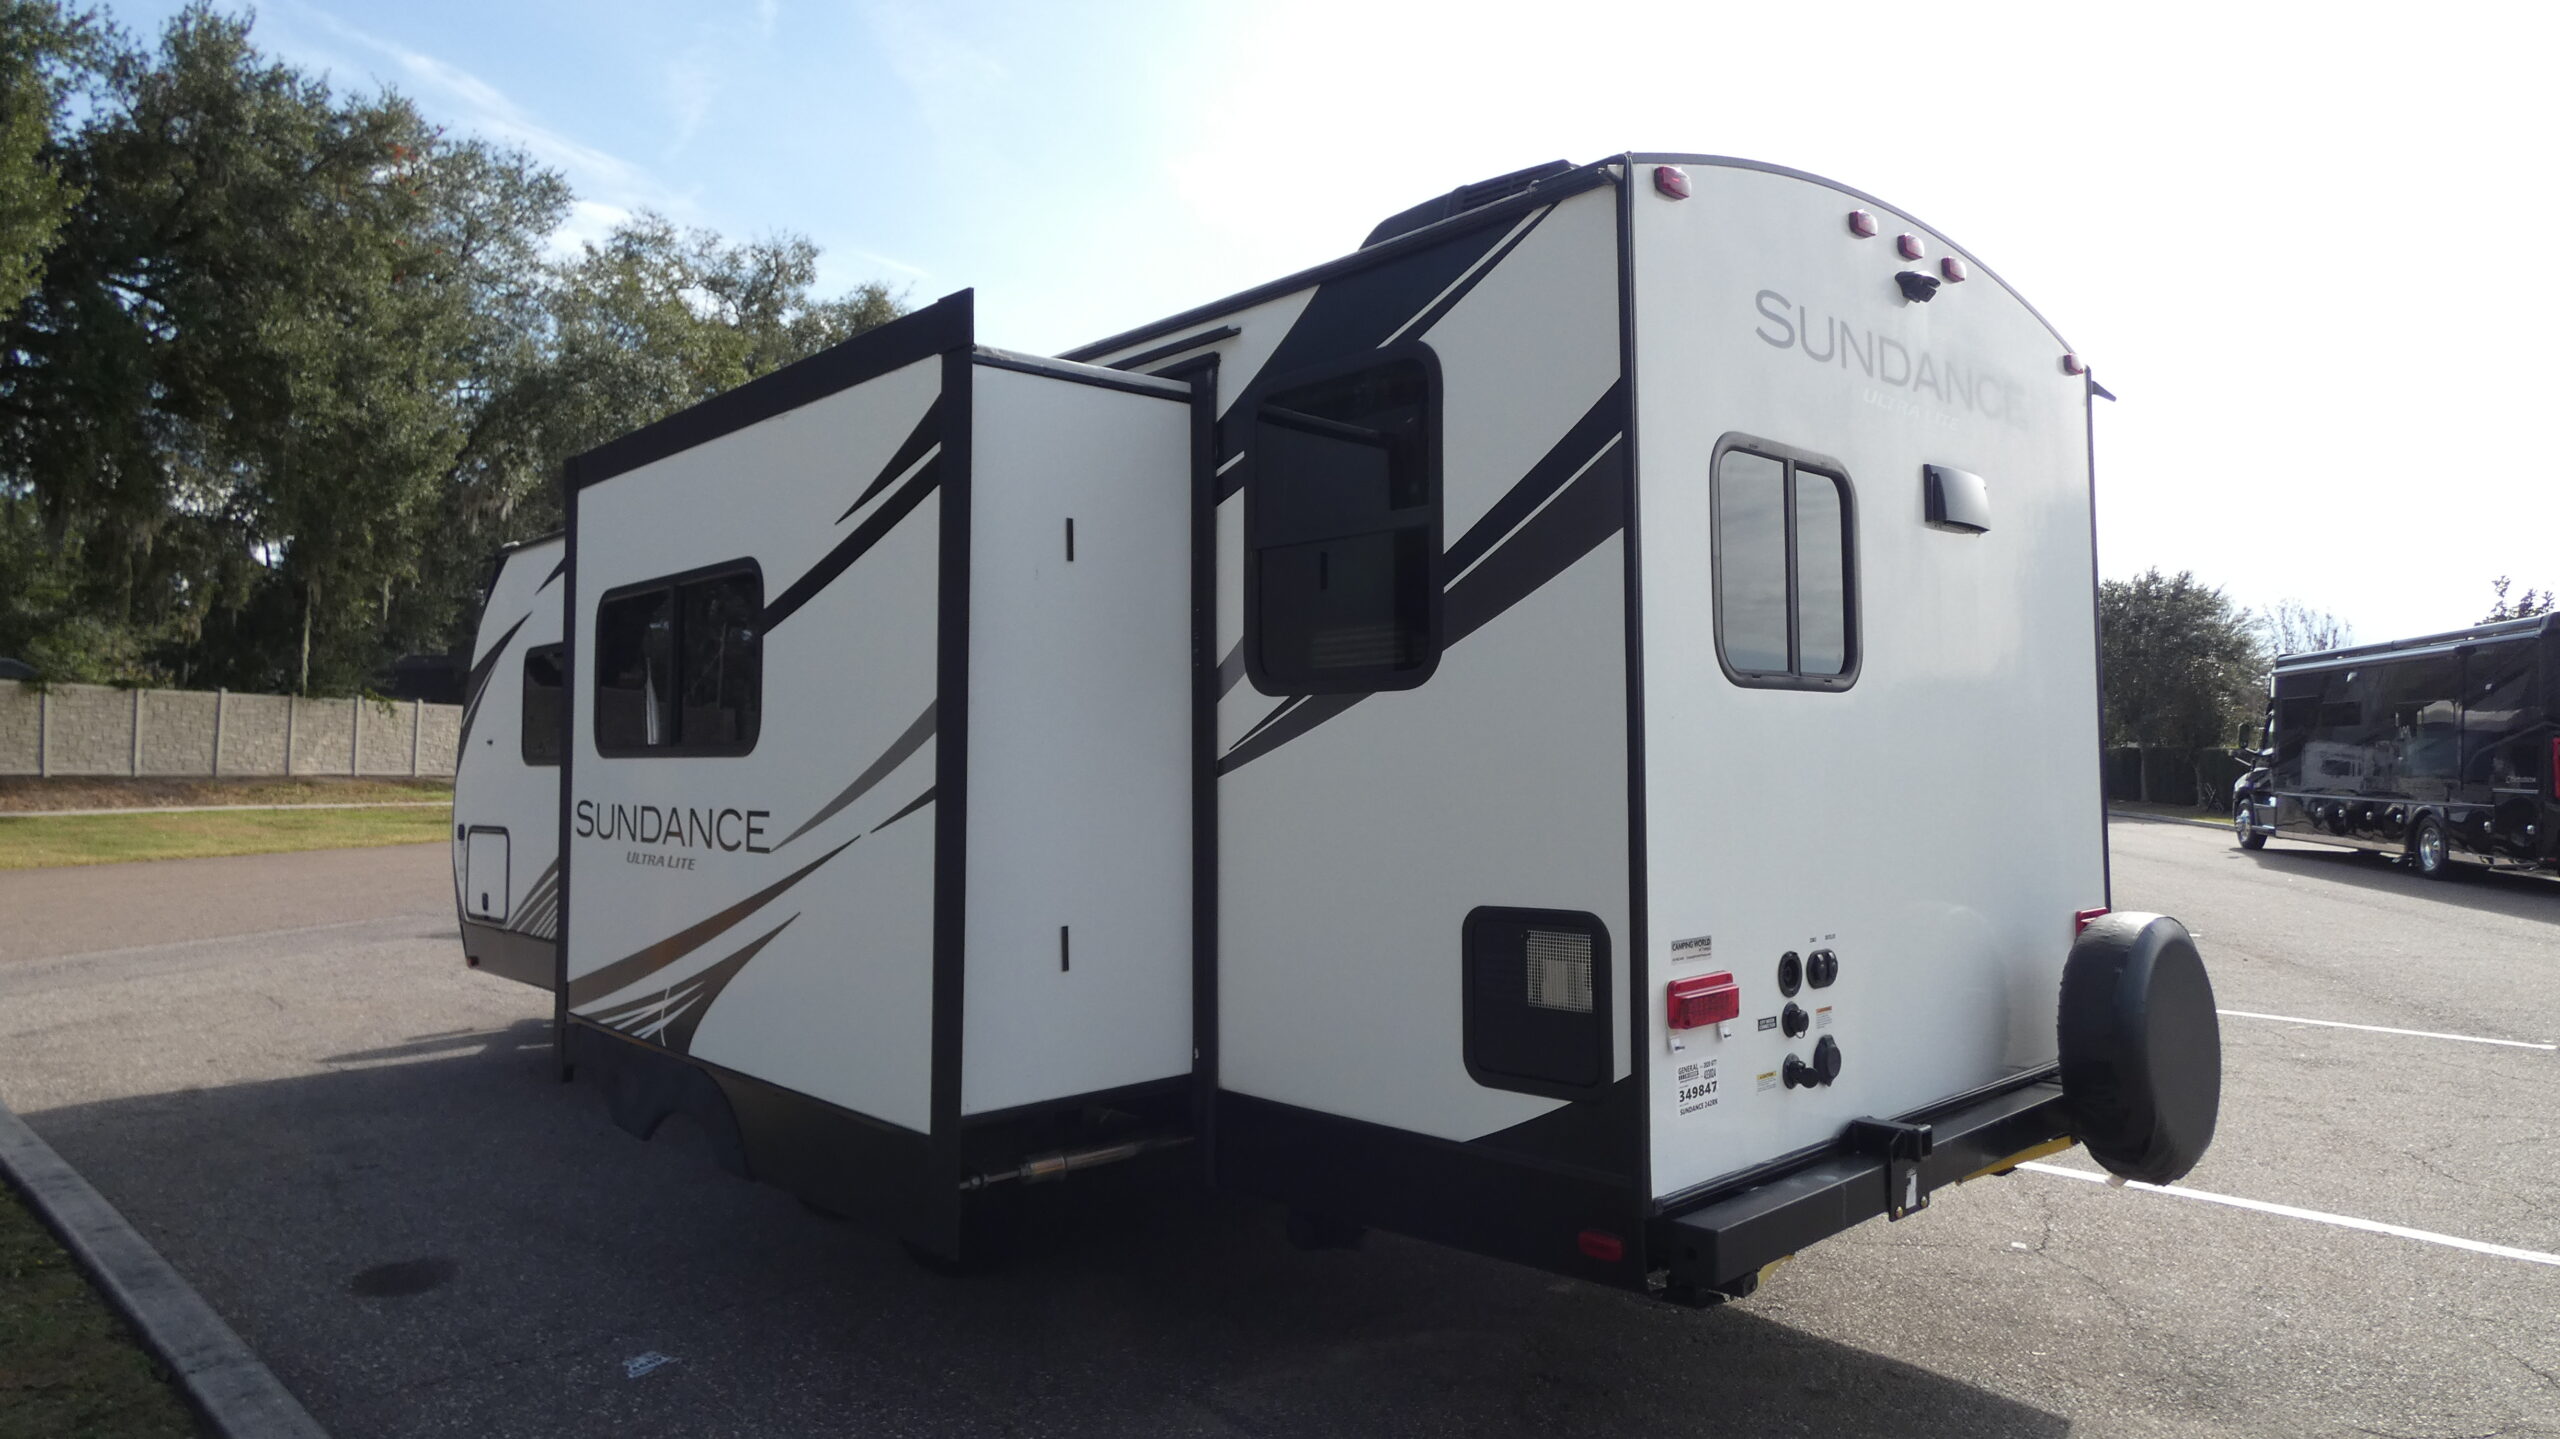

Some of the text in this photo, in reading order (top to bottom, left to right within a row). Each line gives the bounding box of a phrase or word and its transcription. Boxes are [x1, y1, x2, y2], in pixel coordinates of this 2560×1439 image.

[1755, 289, 2028, 432] SUNDANCE
[1863, 387, 1961, 432] ULTRA LITE
[576, 799, 770, 854] SUNDANCE
[626, 850, 696, 871] ULTRA LITE
[1672, 940, 1694, 951] CAMPING
[1694, 937, 1712, 947] WORLD
[1678, 1063, 1699, 1075] GENERAL
[1679, 1081, 1717, 1103] 349847
[1680, 1102, 1704, 1116] SUNDANCE
